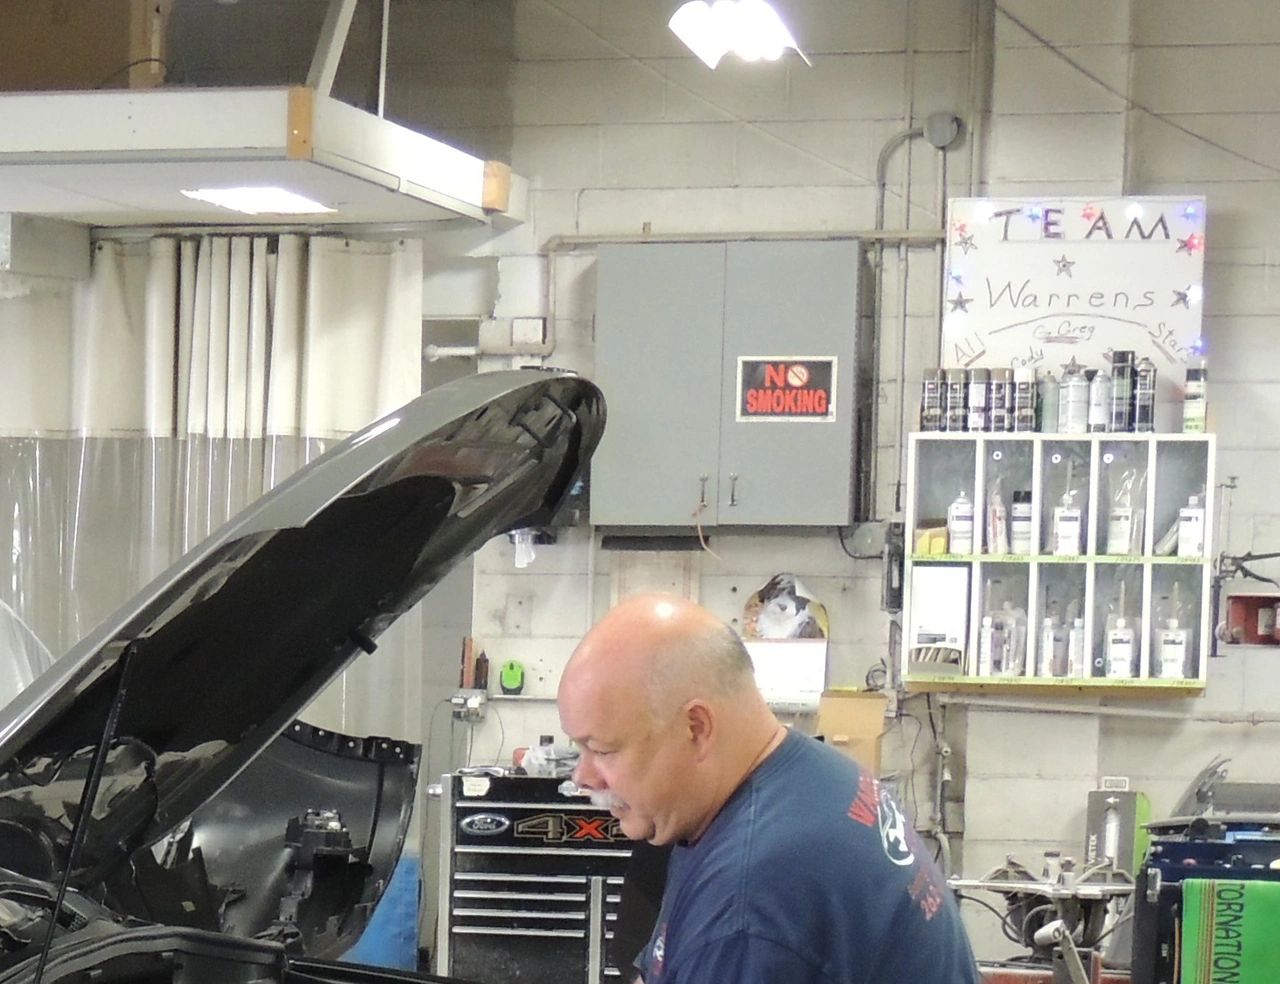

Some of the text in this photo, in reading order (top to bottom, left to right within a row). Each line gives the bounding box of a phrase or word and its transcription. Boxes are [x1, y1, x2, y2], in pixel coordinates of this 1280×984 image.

[990, 208, 1171, 241] TEAM
[985, 277, 1156, 310] Warrens
[953, 331, 986, 363] All
[764, 363, 809, 387] NO
[747, 388, 827, 414] SMOKING
